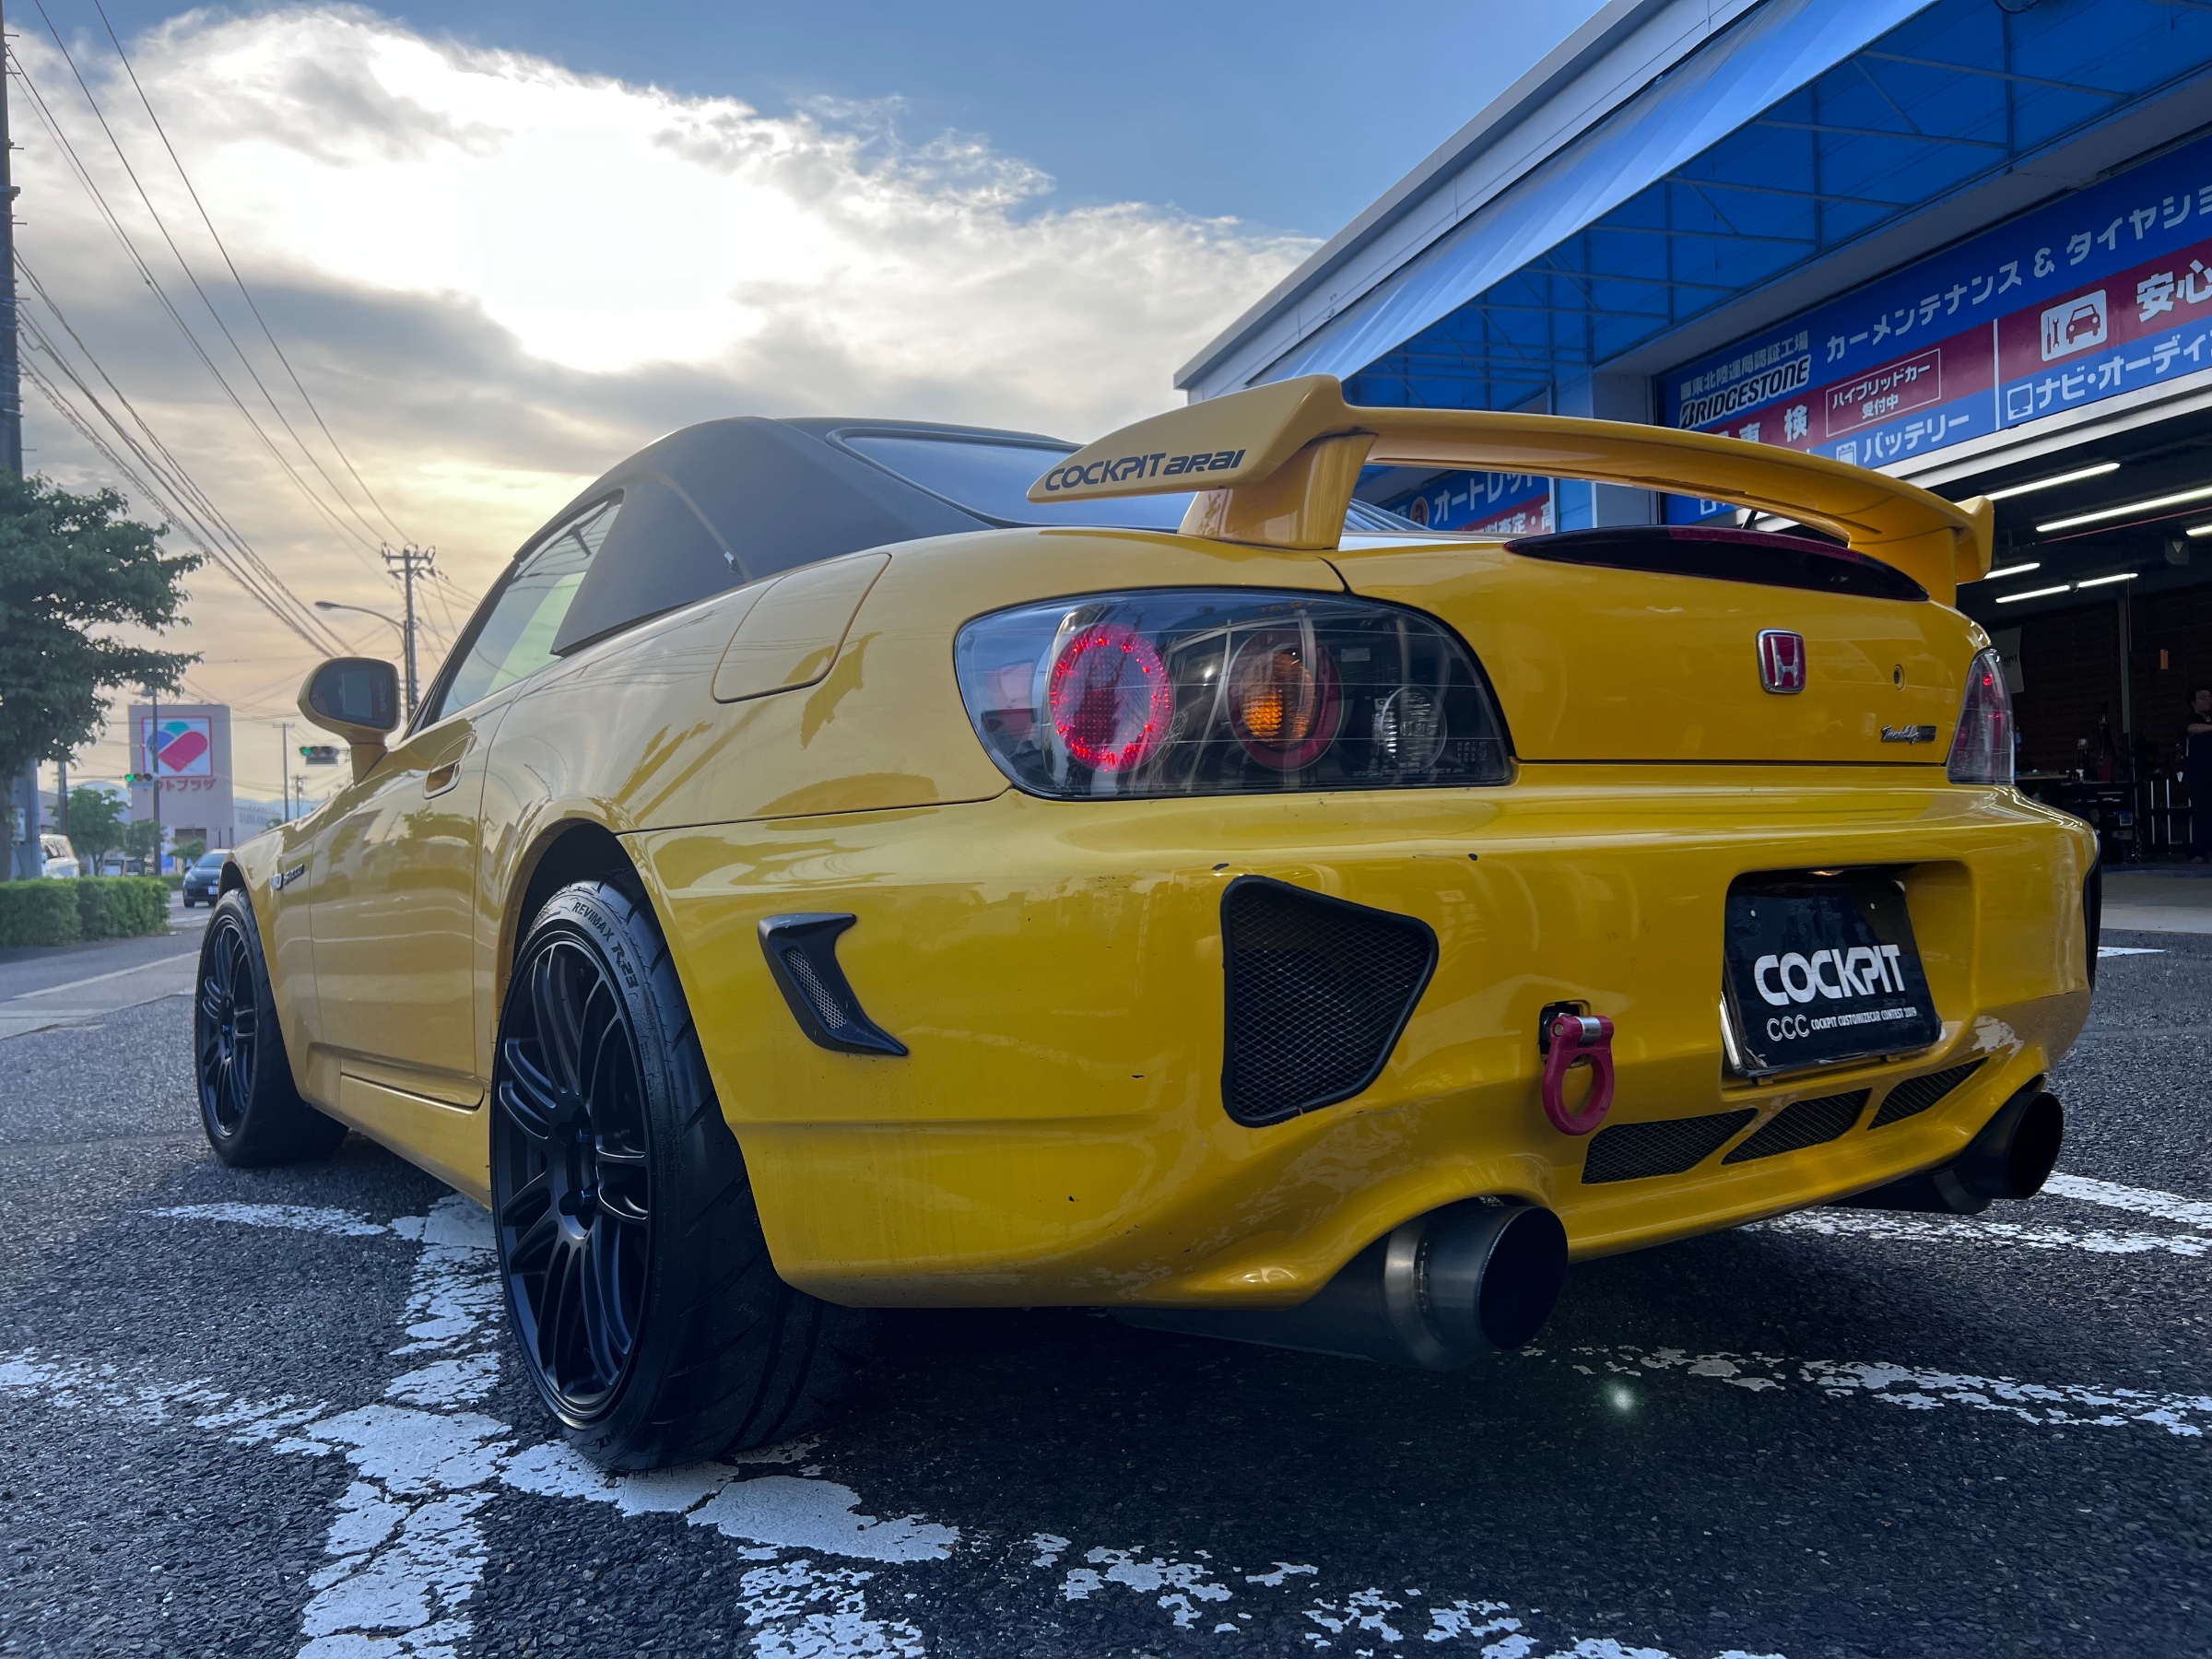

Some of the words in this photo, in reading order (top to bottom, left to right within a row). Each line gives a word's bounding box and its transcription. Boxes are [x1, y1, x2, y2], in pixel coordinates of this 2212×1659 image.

[1827, 260, 2022, 363] カーメンテナンス
[2033, 247, 2055, 278] &
[1679, 354, 1810, 429] BRIDGESTONE
[1832, 364, 1931, 410] ハイブリッドカー
[2036, 330, 2212, 409] ナビ・オーディ
[1862, 394, 1899, 419] 受付中
[1863, 414, 1970, 464] バッテリー
[1044, 452, 1167, 491] COCKPIT
[571, 901, 616, 943] REVIMAX
[1754, 944, 1906, 1006] COCKPIT
[1766, 1014, 1811, 1041] CCC
[1810, 1017, 1838, 1031] COCKPIT
[1881, 1008, 1904, 1022] CONTEST
